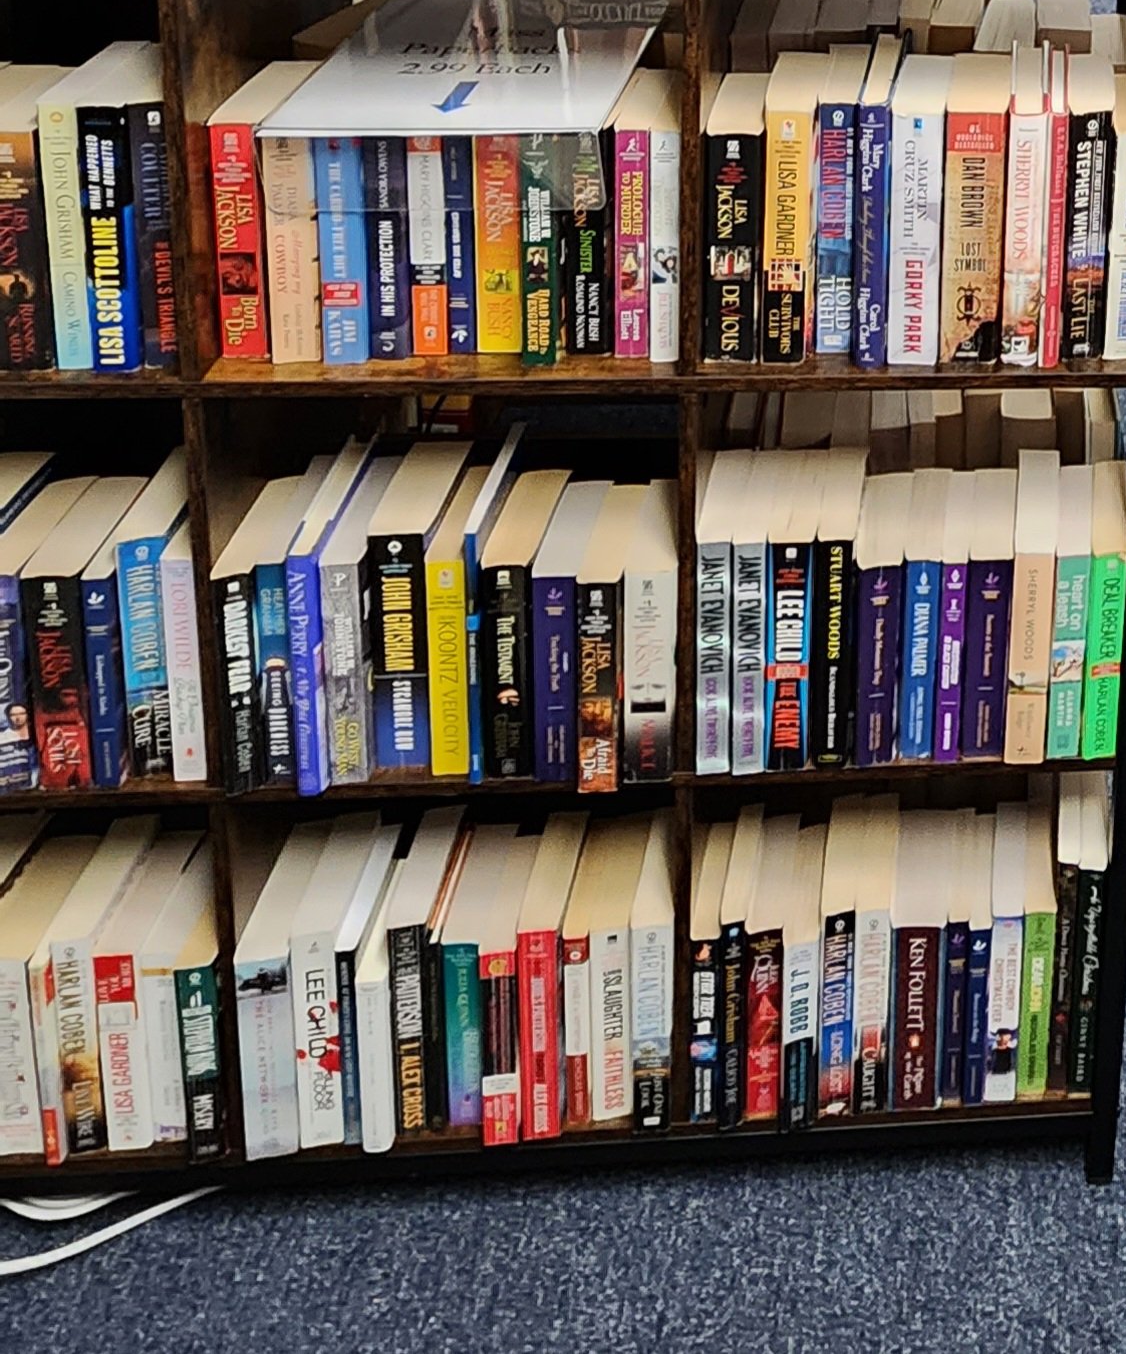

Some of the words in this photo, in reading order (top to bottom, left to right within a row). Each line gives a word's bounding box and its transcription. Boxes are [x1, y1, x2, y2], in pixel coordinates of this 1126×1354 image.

[85, 134, 100, 186] HAPPENED
[822, 128, 847, 186] HARLAN
[860, 127, 875, 164] Higgins
[868, 142, 885, 169] Mary
[903, 139, 916, 180] CRUZ
[53, 148, 68, 191] JOHN
[620, 171, 632, 185] TO
[778, 159, 797, 191] LISA
[860, 165, 875, 192] Clark
[914, 158, 930, 222] MARTIN
[961, 157, 986, 181] DAN
[1013, 139, 1031, 203] SHERRYL
[1074, 141, 1092, 211] STEPHEN
[90, 187, 102, 211] WHAT
[213, 184, 240, 252] JACKSON
[235, 192, 253, 225] LISA
[620, 187, 632, 236] MURDER
[631, 171, 644, 237] PROLOGUE
[715, 184, 734, 239] JACKSON
[733, 198, 748, 224] LISA
[820, 189, 847, 238] COBEN
[902, 183, 916, 239] SMITH
[959, 182, 985, 228] BROWN
[55, 193, 75, 260] GRISHAM
[775, 193, 795, 257] GARDNER
[1012, 206, 1029, 260] WOODS
[1070, 211, 1090, 259] WHITE
[91, 215, 124, 318] SCOTTOLINE
[379, 220, 394, 282] PROTECTION
[579, 229, 594, 274] SINISTER
[953, 259, 987, 273] SYMBOL
[960, 242, 982, 256] LOST
[380, 283, 394, 303] HIS
[858, 287, 872, 324] Higgins
[903, 259, 924, 309] GORKY
[1069, 276, 1089, 314] LAST
[380, 304, 395, 317] IN
[720, 284, 740, 352] DEVIOUS
[869, 304, 881, 332] Carol
[1068, 314, 1086, 340] LIE
[100, 319, 126, 366] LISA
[858, 325, 871, 350] Clark
[902, 313, 923, 355] PARK
[126, 565, 157, 621] HARLAN
[381, 576, 412, 612] JOHN
[700, 555, 725, 595] JANET
[736, 555, 762, 595] JANET
[827, 545, 843, 603] STUART
[1071, 574, 1087, 610] heart
[1102, 576, 1121, 606] DEAL
[496, 615, 516, 634] THE
[776, 589, 805, 619] LEE
[1069, 612, 1084, 631] on
[131, 621, 160, 672] COBEN
[224, 600, 250, 658] DARKEST
[382, 613, 415, 672] GRISHAM
[699, 598, 725, 675] EVANOVICH
[736, 599, 762, 673] EVANOVICH
[774, 619, 804, 662] CHILD
[827, 604, 842, 660] WOODS
[1100, 607, 1120, 659] BREAKER
[228, 659, 252, 695] FEAR
[496, 635, 516, 686] TESTAMENT
[580, 636, 598, 694] JACKSON
[596, 643, 612, 670] LISA
[595, 738, 613, 775] Afraid
[824, 934, 847, 983] HARLAN
[908, 937, 928, 969] KEN
[304, 968, 326, 1003] LEE
[395, 973, 423, 1041] PATTERSON
[602, 975, 624, 1042] SLAUGHTER
[822, 982, 846, 1027] COBEN
[905, 970, 928, 1032] FOLLETT
[306, 1005, 329, 1059] CHILD
[108, 1032, 133, 1086] GARDNER
[603, 1049, 625, 1112] FAITHLESS
[114, 1088, 134, 1115] LISA
